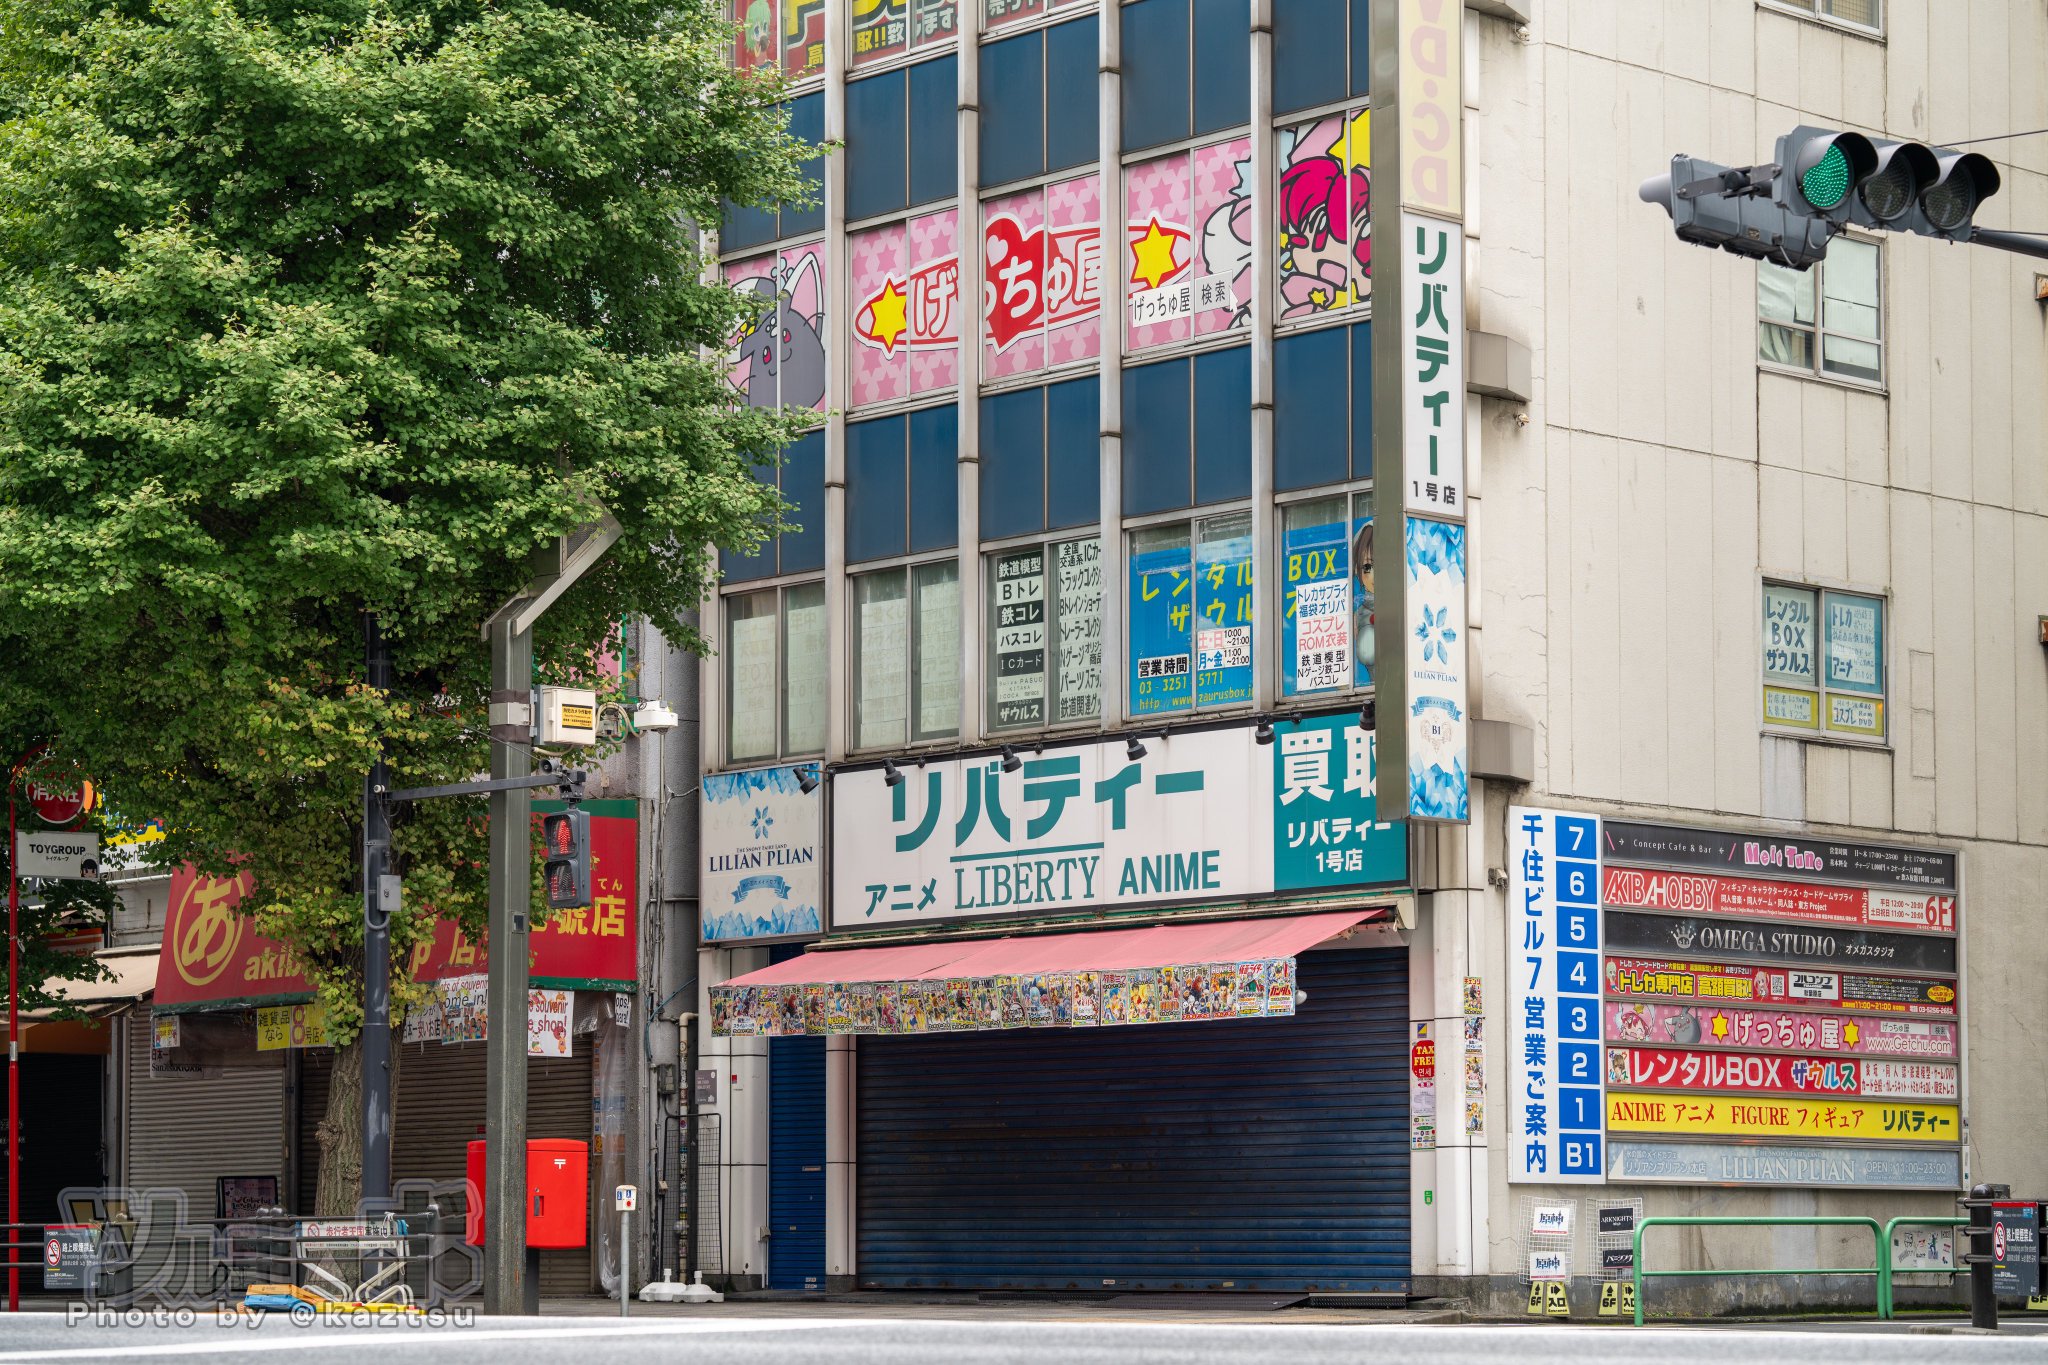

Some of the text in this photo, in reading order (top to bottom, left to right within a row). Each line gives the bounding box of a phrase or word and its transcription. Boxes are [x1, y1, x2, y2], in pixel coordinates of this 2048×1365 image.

[1133, 279, 1226, 323] げっちゅ屋 検索
[1416, 226, 1449, 477] リバティー
[1413, 480, 1456, 506] 1号店
[1060, 553, 1083, 568] 交通系
[1063, 543, 1078, 556] 全国
[998, 556, 1042, 579] 鉄道模型
[1288, 548, 1337, 582] BOX
[1003, 580, 1039, 601] Bトレ
[1297, 583, 1348, 604] トレカサプライ
[1001, 603, 1039, 625] 鉄コレ
[1299, 599, 1346, 619] 福袋オリパ
[1766, 594, 1810, 624] レンタル
[1832, 605, 1852, 629] トレカ
[1224, 628, 1242, 638] 10:00
[1302, 616, 1345, 636] コスプレ
[1772, 622, 1806, 649] BOX
[1000, 629, 1043, 648] バスコレ
[1298, 631, 1348, 652] ROM衣装
[1001, 653, 1042, 670] ICカード
[1224, 648, 1242, 658] 11:00
[1302, 649, 1346, 667] 鉄道模型
[1766, 648, 1810, 675] ザウルス
[1138, 656, 1188, 678] 営業時間
[1310, 674, 1339, 688] バスコレ
[1000, 704, 1040, 722] ザウルス
[1431, 725, 1441, 735] B1
[892, 755, 1204, 853] リバティー
[1287, 817, 1391, 849] リバティー
[1568, 826, 1585, 851] 7
[29, 844, 86, 856] TOYGROUP
[1633, 838, 1712, 854] Concept Cafe & Bar
[709, 846, 813, 872] LILIAN PLIAN
[1315, 848, 1363, 874] 1号店
[1785, 845, 1824, 872] Tune
[598, 878, 623, 891] てん
[865, 850, 1221, 918] アニメ LIBERTY ANIME
[1569, 871, 1585, 896] 6
[182, 873, 232, 969] あ
[1569, 916, 1586, 941] 5
[1700, 926, 1895, 958] OMEGA STUDIO オメガスタジオ
[1569, 961, 1587, 986] 4
[1618, 968, 1695, 996] トレカ専門店
[1522, 814, 1547, 1174] 千住ビル7営業ご案内
[536, 999, 568, 1014] souvenir
[258, 1010, 290, 1028] 雑貨品
[1571, 1007, 1587, 1033] 3
[1733, 1011, 1840, 1050] げっちゅ屋
[1882, 1022, 1910, 1032] げっちゅ屋
[264, 1029, 283, 1042] なら
[1865, 1036, 1952, 1053] www.Getchu.com
[1416, 1045, 1435, 1055] TAX
[1572, 1052, 1588, 1077] 2
[1634, 1050, 1857, 1092] レンタルBOX ザウルス
[1575, 1097, 1584, 1122] 1
[1611, 1101, 1950, 1133] ANIME アニメ FIGURE フィギュア リバティー
[1566, 1142, 1594, 1168] B1
[1721, 1156, 1790, 1180] LILIAN
[1796, 1158, 1856, 1181] PLIAN
[1866, 1161, 1888, 1173] OPEN
[1600, 1215, 1633, 1223] ARKNIGHTS
[1530, 1296, 1566, 1307] 6F 入口
[1602, 1297, 1616, 1307] 6F
